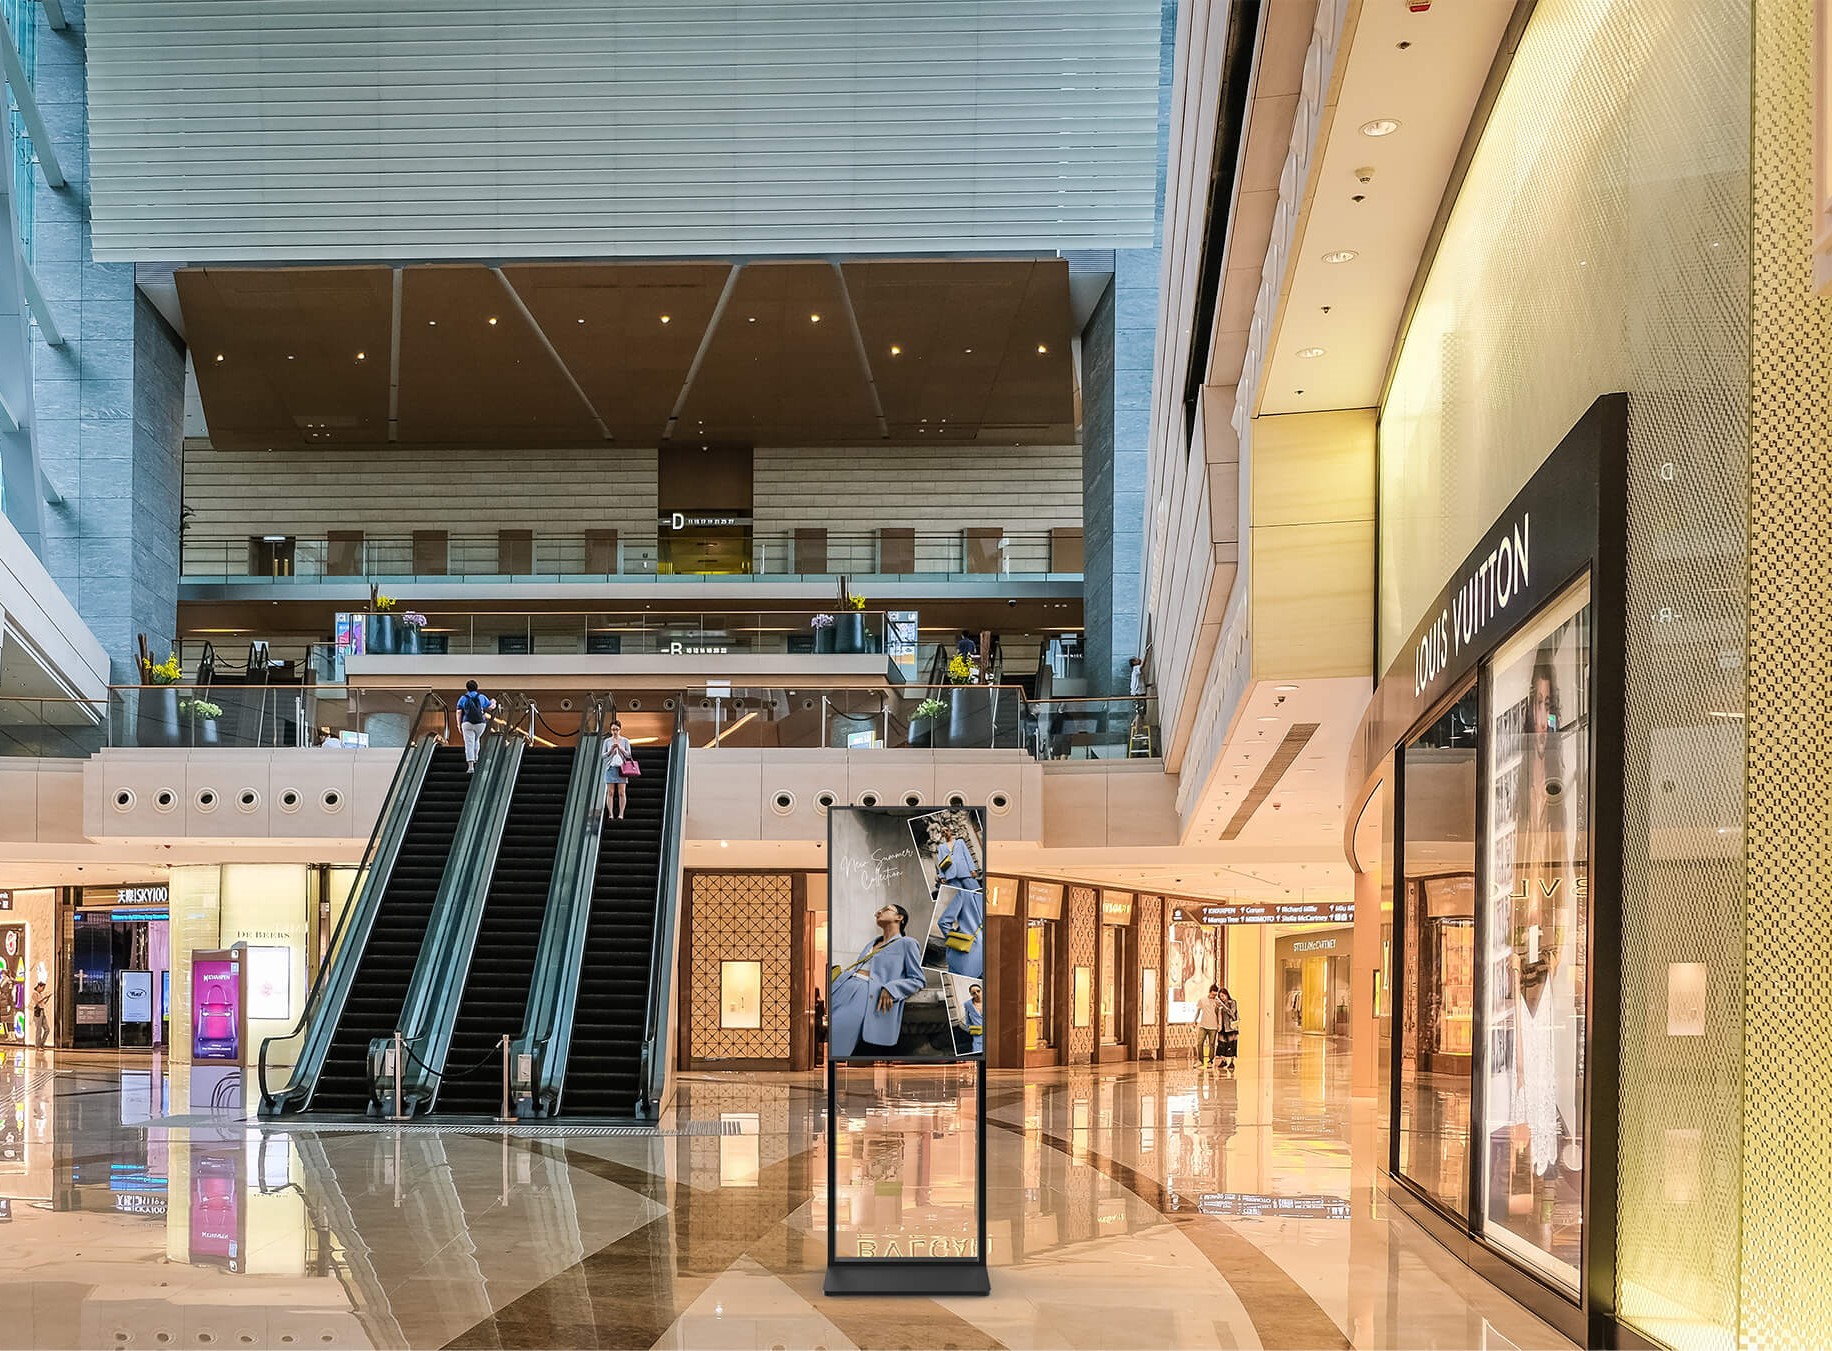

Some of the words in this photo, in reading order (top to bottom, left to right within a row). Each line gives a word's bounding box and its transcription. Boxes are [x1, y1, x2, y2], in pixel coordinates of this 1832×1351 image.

[672, 513, 684, 529] D
[1414, 608, 1448, 698] LOUIS
[1452, 511, 1530, 657] VUITTON
[670, 642, 683, 655] R
[840, 855, 869, 879] New
[871, 848, 913, 863] Summer
[862, 862, 904, 890] Collection
